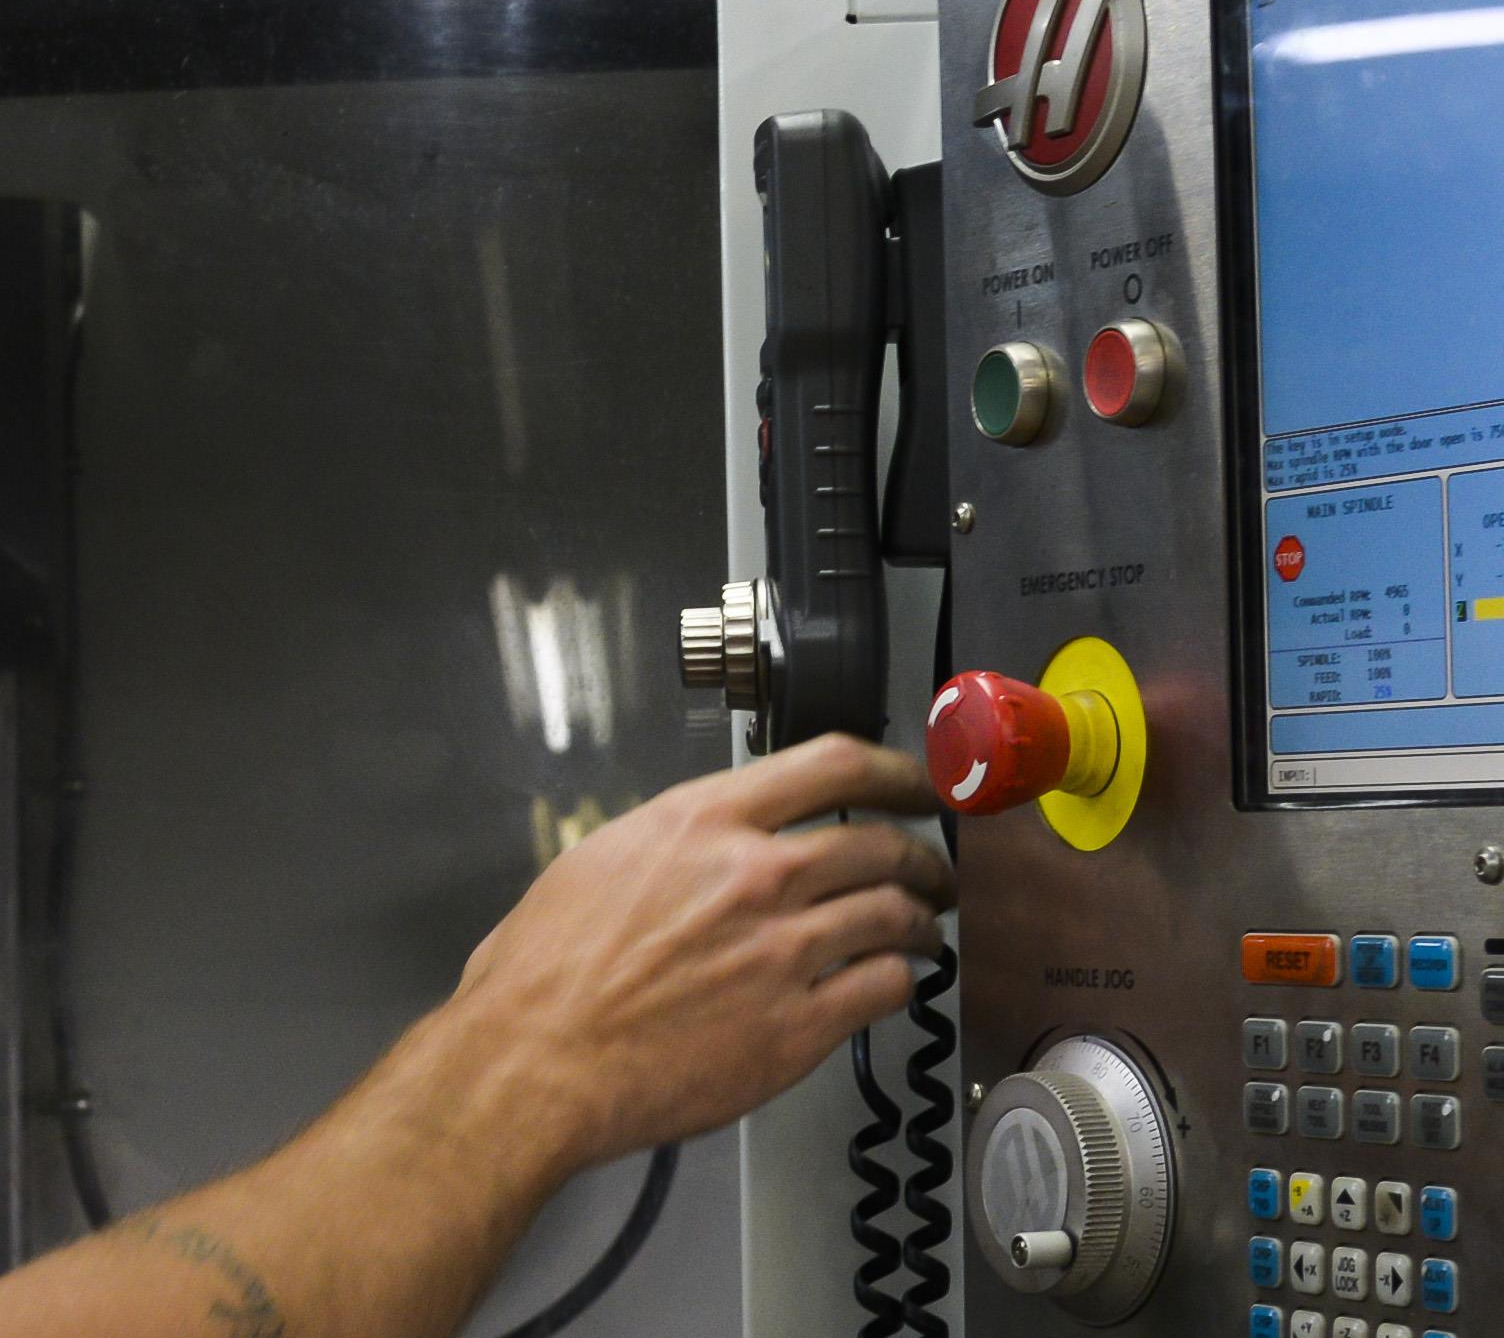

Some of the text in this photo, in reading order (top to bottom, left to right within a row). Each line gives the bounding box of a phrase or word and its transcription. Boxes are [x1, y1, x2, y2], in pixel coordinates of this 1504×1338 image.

[1090, 232, 1174, 270] POWER OFF
[981, 262, 1055, 296] POWER ON
[1288, 440, 1305, 456] key
[1311, 435, 1322, 449] is
[1328, 434, 1340, 446] in
[1344, 429, 1376, 446] setup
[1288, 451, 1329, 470] spindle
[1356, 444, 1381, 459] with
[1385, 441, 1404, 454] the
[1409, 437, 1432, 451] door
[1439, 433, 1466, 449] open
[1470, 427, 1484, 442] is
[1288, 465, 1319, 485] rapid
[1323, 464, 1334, 480] is
[1340, 463, 1358, 478] 25%
[1306, 495, 1394, 519] MAIN SPINDLE
[1275, 551, 1304, 567] STOP
[1453, 542, 1464, 558] X
[1019, 562, 1145, 596] EMERGENCY STOP
[1454, 572, 1465, 588] Y
[1310, 608, 1345, 625] Actual
[1344, 624, 1372, 641] Load:
[1297, 648, 1392, 667] SPINDLE: 100%
[1314, 666, 1392, 684] FEED: 100%
[1278, 769, 1310, 783] INPUT:
[1265, 949, 1311, 972] RESET
[1044, 966, 1135, 990] HANDLE JOG
[1252, 1034, 1270, 1056] F1
[1304, 1037, 1325, 1059] F2
[1360, 1040, 1383, 1062] F3
[1419, 1043, 1440, 1065] F4
[1092, 1061, 1108, 1080] 80
[1125, 1112, 1142, 1134] 70
[1139, 1186, 1154, 1210] 60
[1337, 1256, 1356, 1273] JOG
[1334, 1275, 1361, 1293] LOCK
